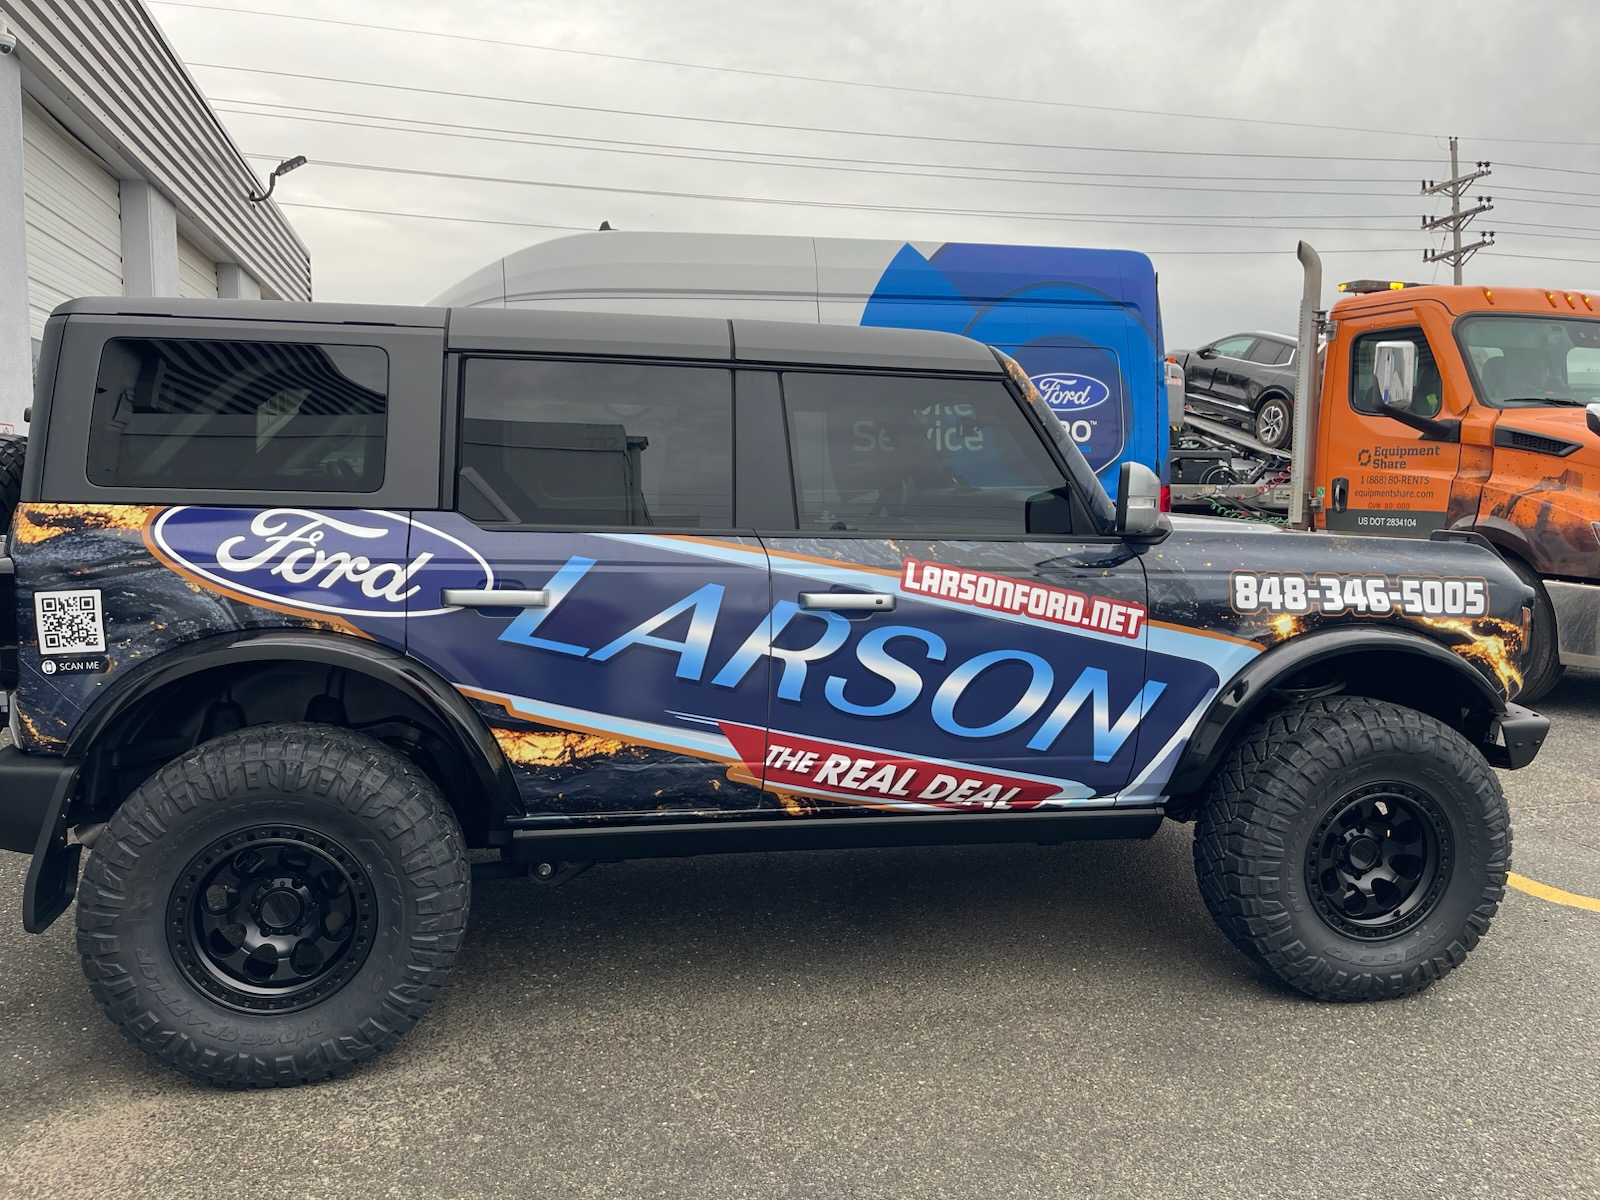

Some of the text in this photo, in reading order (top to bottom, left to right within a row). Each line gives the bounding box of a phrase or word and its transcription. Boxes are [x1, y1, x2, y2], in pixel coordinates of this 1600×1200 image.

[1039, 377, 1092, 405] Ford
[1374, 446, 1440, 458] Equipment
[1373, 458, 1407, 469] Share
[1360, 475, 1430, 485] 1 (888) 80-RENTS
[1354, 488, 1434, 498] equipmentshare.com
[1358, 516, 1417, 527] US DOT 2834104
[215, 508, 435, 602] Ford
[904, 561, 1145, 635] LARSONFORD.NET
[1235, 575, 1485, 615] 848-346-5005
[59, 661, 100, 671] SCAN ME
[499, 554, 1168, 764] LARSON
[764, 744, 1022, 810] THE REAL DEAL
